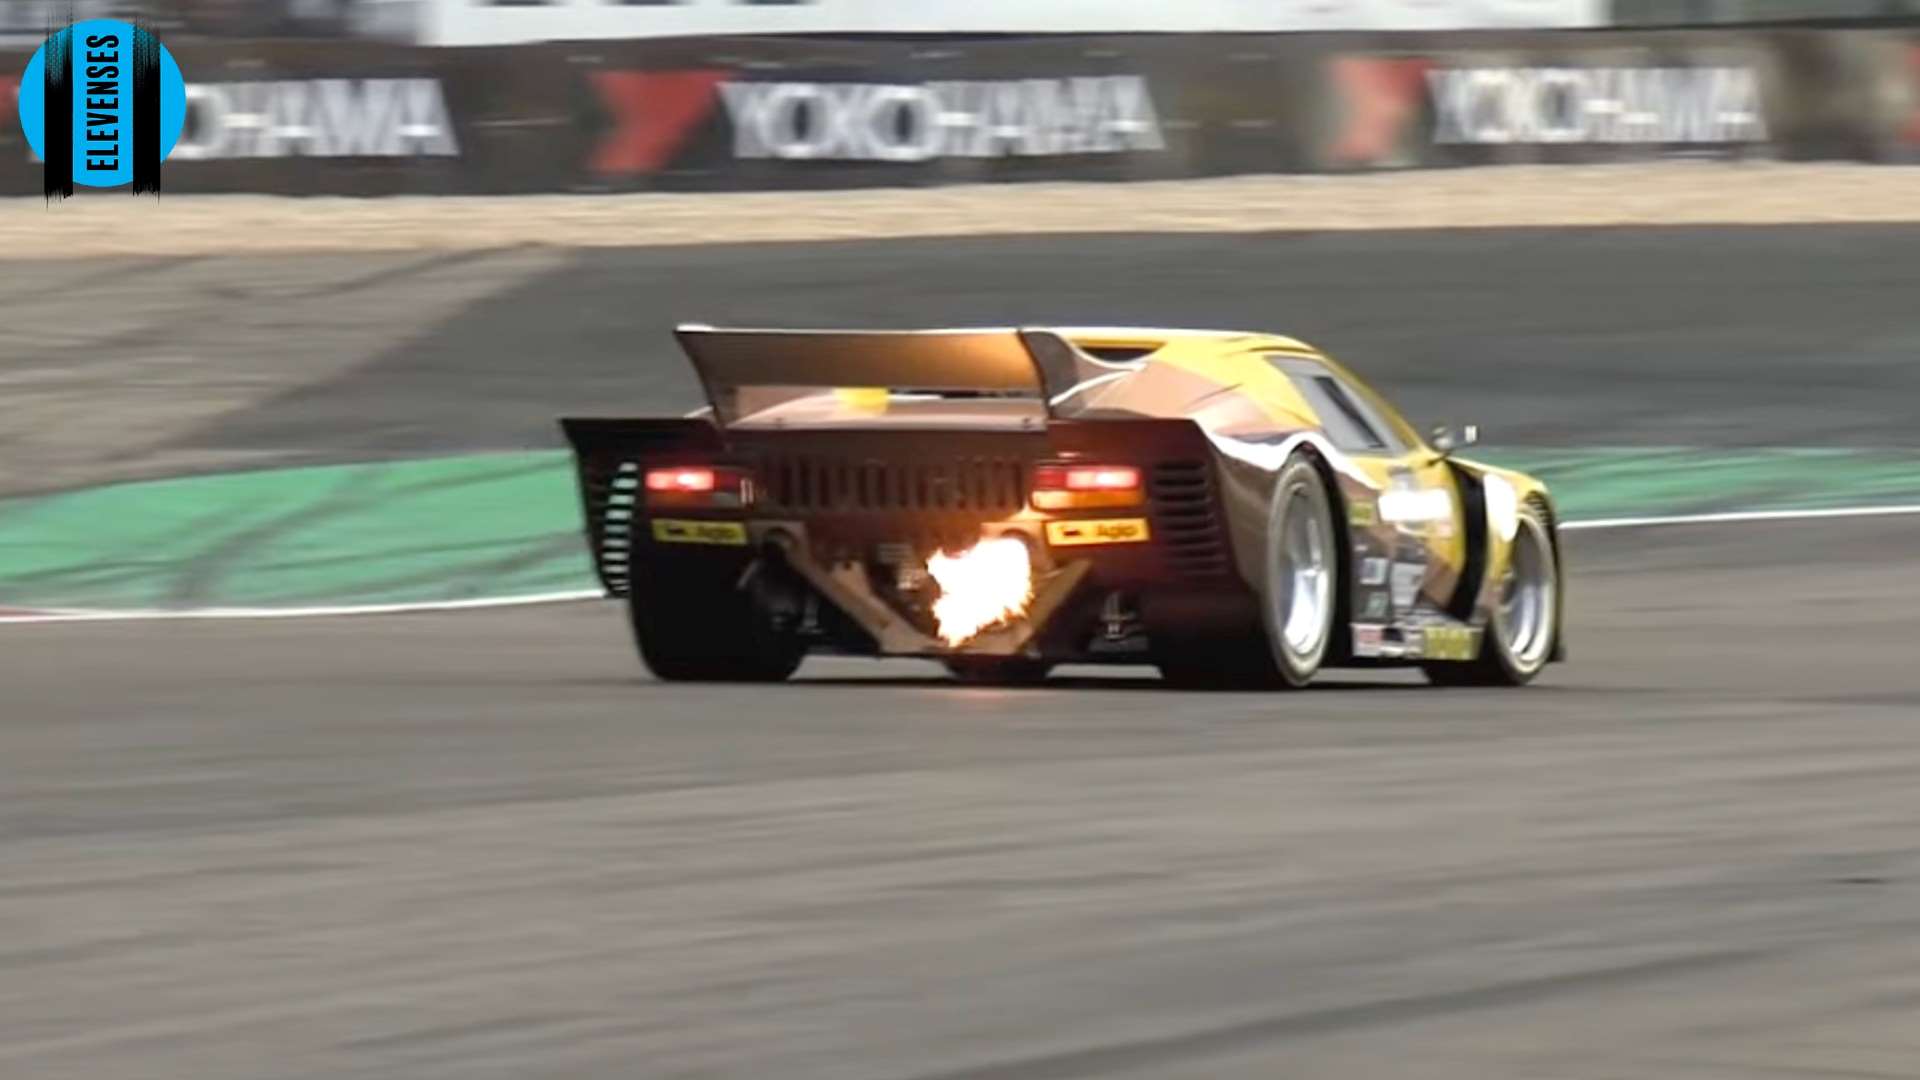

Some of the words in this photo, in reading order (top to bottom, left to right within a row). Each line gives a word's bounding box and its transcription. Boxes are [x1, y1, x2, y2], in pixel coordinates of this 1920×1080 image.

[174, 77, 460, 160] OHAMA
[715, 75, 1165, 160] YOKOHAMA
[1426, 67, 1768, 144] YOKOHAMA
